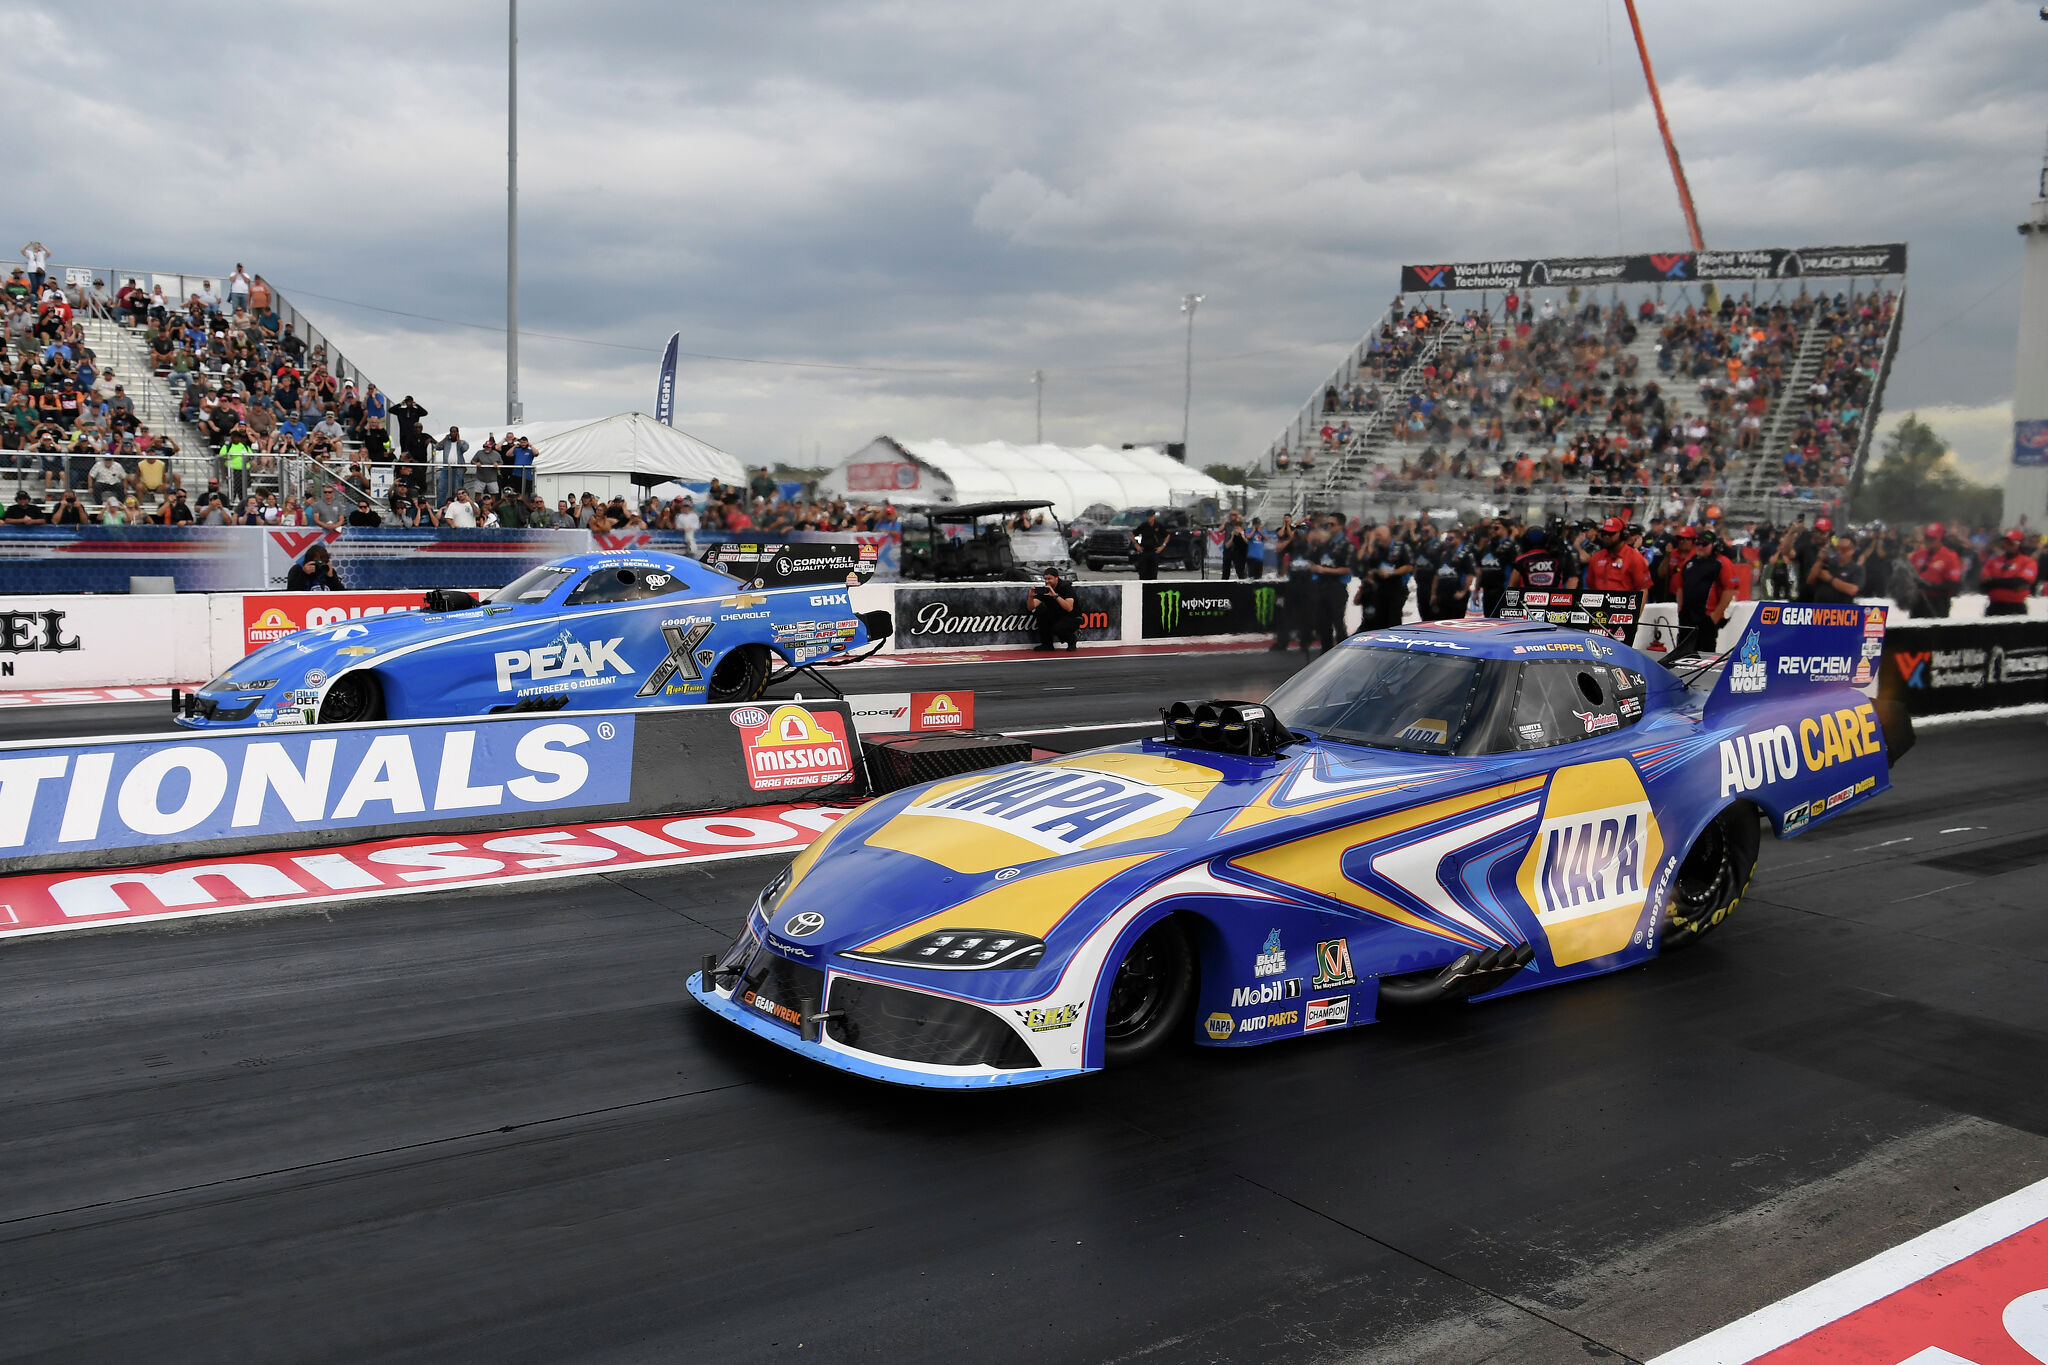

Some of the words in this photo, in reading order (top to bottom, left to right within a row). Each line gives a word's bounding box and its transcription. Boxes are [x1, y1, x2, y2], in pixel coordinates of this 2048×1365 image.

[1454, 264, 1488, 277] World
[1490, 262, 1523, 275] Wide
[1453, 274, 1522, 289] Technology
[379, 475, 385, 484] 1
[793, 556, 854, 567] CORNWELL
[793, 564, 826, 572] QUALITY
[1529, 560, 1553, 571] FOX
[809, 594, 848, 607] GHX
[1182, 598, 1232, 610] MONSTER
[1526, 594, 1547, 603] SIMPSON
[1610, 596, 1627, 604] WELD
[661, 615, 712, 626] GOODYEAR
[720, 611, 771, 621] CHEVROLET
[1610, 614, 1633, 623] ARP
[1781, 607, 1859, 626] GEARWRENCH
[1375, 634, 1470, 650] Supra
[1546, 643, 1584, 652] CAPPS
[1602, 646, 1613, 655] FC
[494, 637, 636, 692] PEAK
[649, 658, 675, 690] JOHN
[673, 628, 702, 663] FORCE
[1778, 656, 1851, 675] REVCHEM
[1733, 662, 1766, 678] BLUE
[1810, 673, 1850, 682] Composites
[516, 684, 569, 698] ANTIFREEZE
[579, 675, 617, 688] COOLANT
[1730, 676, 1767, 692] WOLF
[296, 690, 319, 698] Blue
[296, 697, 318, 705] DEF
[737, 711, 766, 725] NHRA
[851, 709, 898, 717] ODGE
[923, 714, 960, 725] MISSION
[1719, 724, 1799, 798] AUTO
[1799, 703, 1881, 772] CARE
[756, 747, 843, 772] MISSION
[0, 723, 590, 847] TIONALS
[754, 778, 782, 789] DRAG
[783, 775, 819, 787] RACING
[821, 772, 853, 784] SERIES
[927, 770, 1165, 844] NAPA
[1541, 813, 1639, 912] NAPA
[1646, 855, 1677, 949] GOODYEAR
[768, 934, 814, 958] Supra
[1256, 950, 1286, 966] BLUE
[1254, 961, 1287, 978] WOLF
[1231, 980, 1282, 1008] Mobil
[755, 995, 801, 1026] GEARWRENC
[1308, 1005, 1346, 1021] CHAMPION
[1208, 1019, 1232, 1032] NAPA
[1238, 1015, 1267, 1033] AUTO
[1267, 1010, 1299, 1027] PARTS
